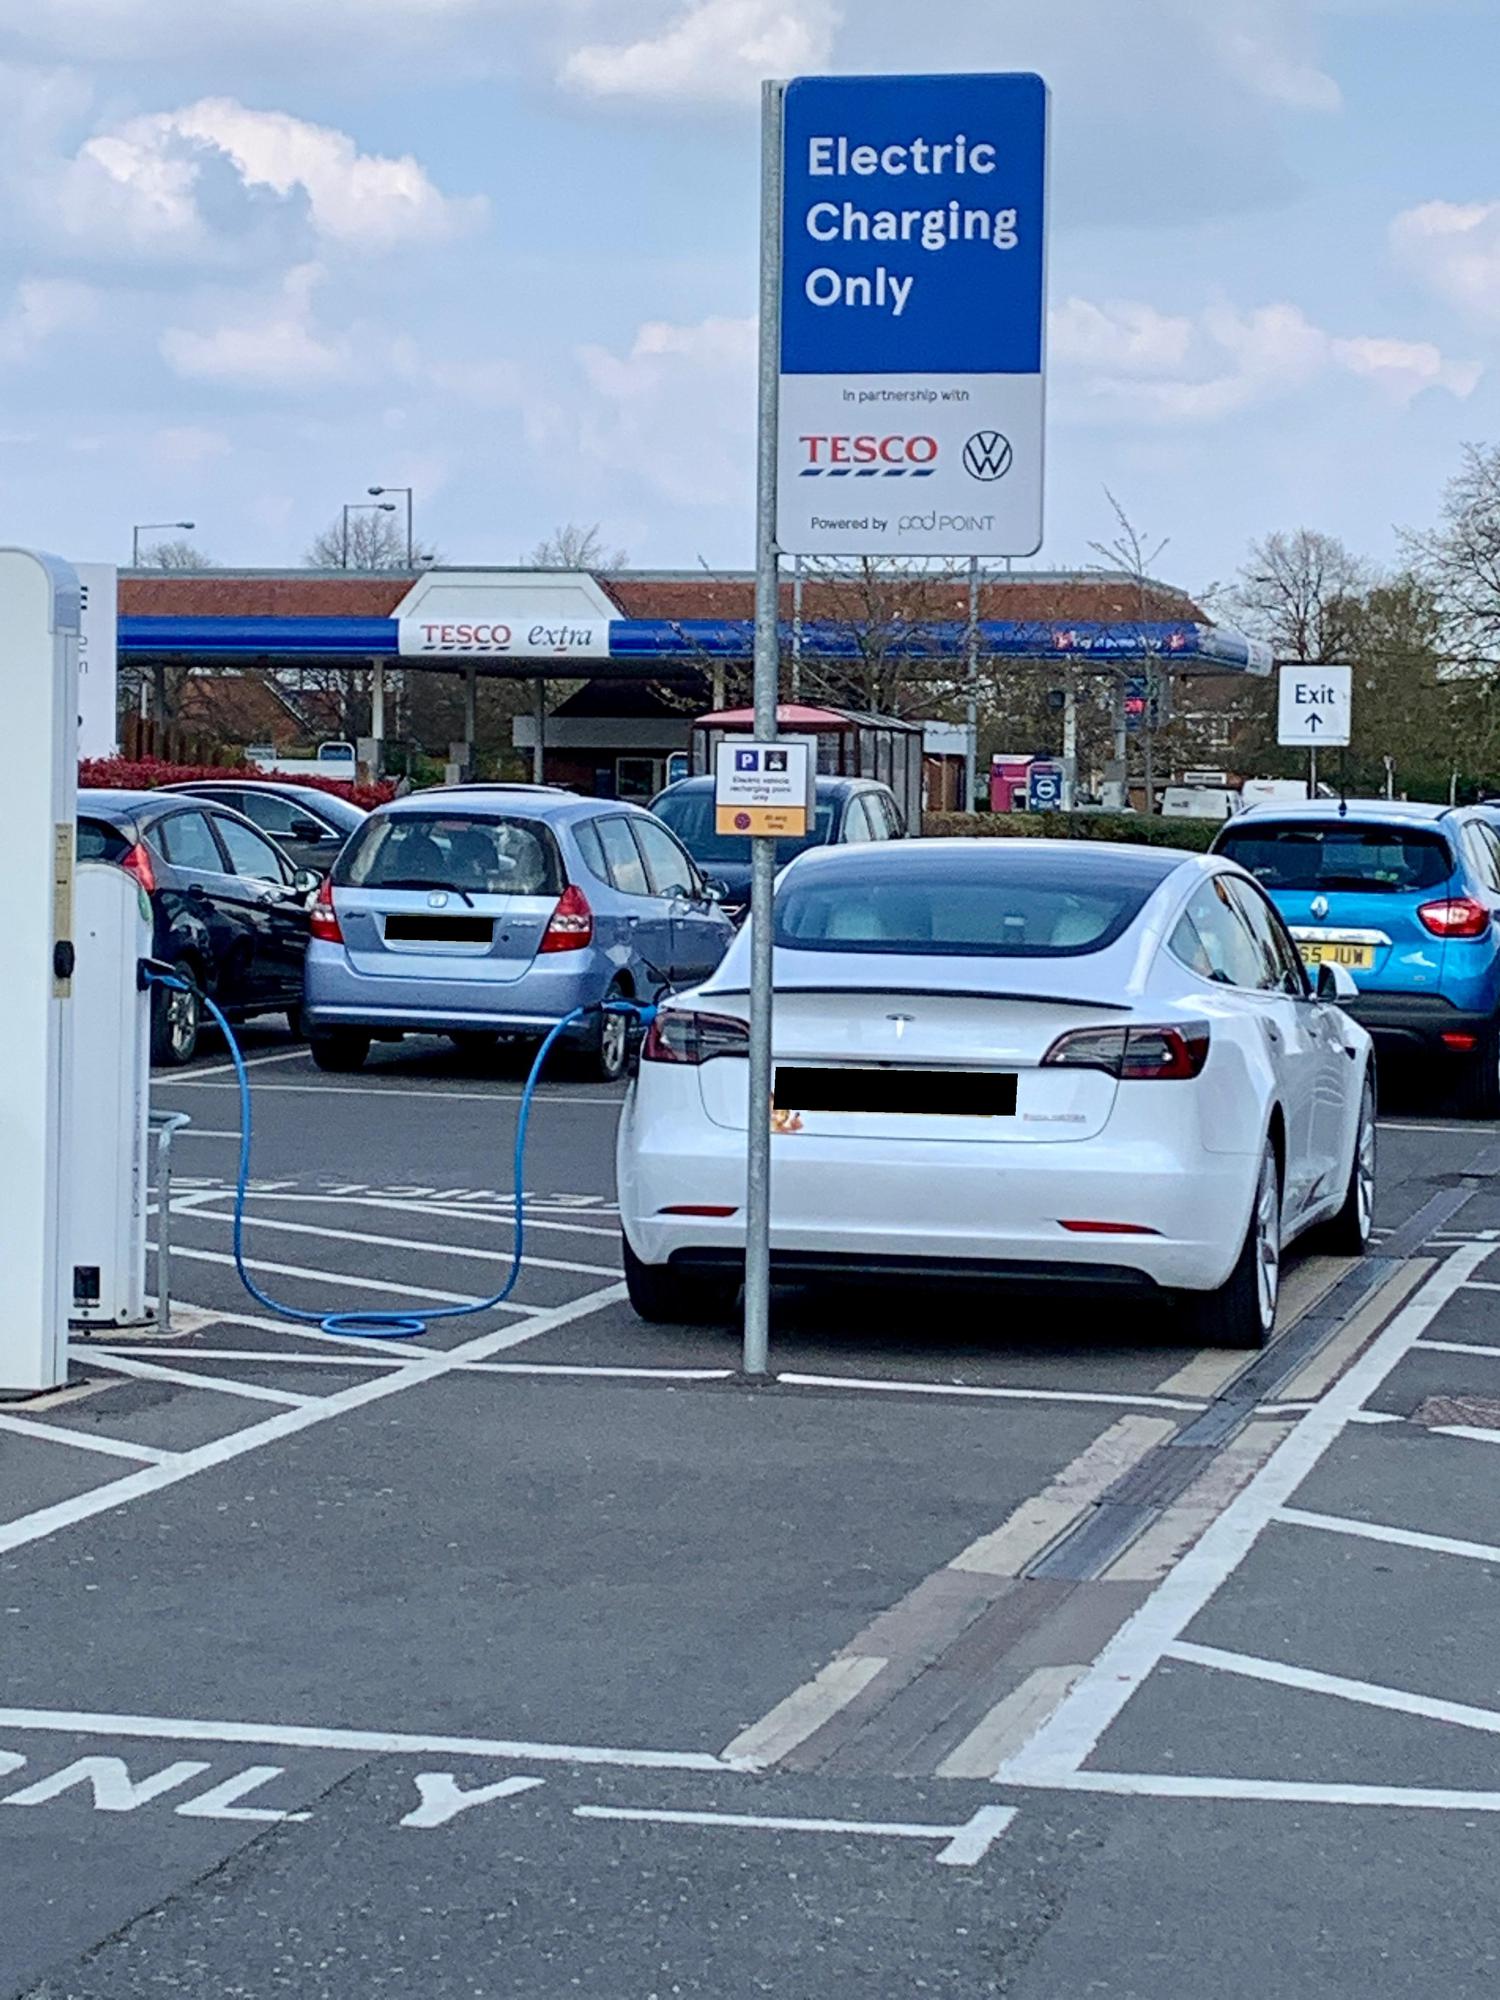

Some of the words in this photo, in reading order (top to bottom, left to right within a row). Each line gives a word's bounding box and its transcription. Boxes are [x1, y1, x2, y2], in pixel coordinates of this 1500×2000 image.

[808, 134, 997, 176] Electric
[806, 200, 1018, 250] Charging
[805, 267, 914, 316] Only
[843, 389, 855, 401] In
[858, 389, 938, 403] partnership
[941, 390, 970, 401] with
[799, 435, 939, 464] TESCO
[811, 516, 869, 530] Powered
[872, 516, 888, 532] by
[420, 624, 512, 644] TESCO
[527, 625, 592, 646] extra
[1295, 684, 1335, 704] Exit
[741, 753, 753, 769] P
[169, 1177, 620, 1208] EHICLES
